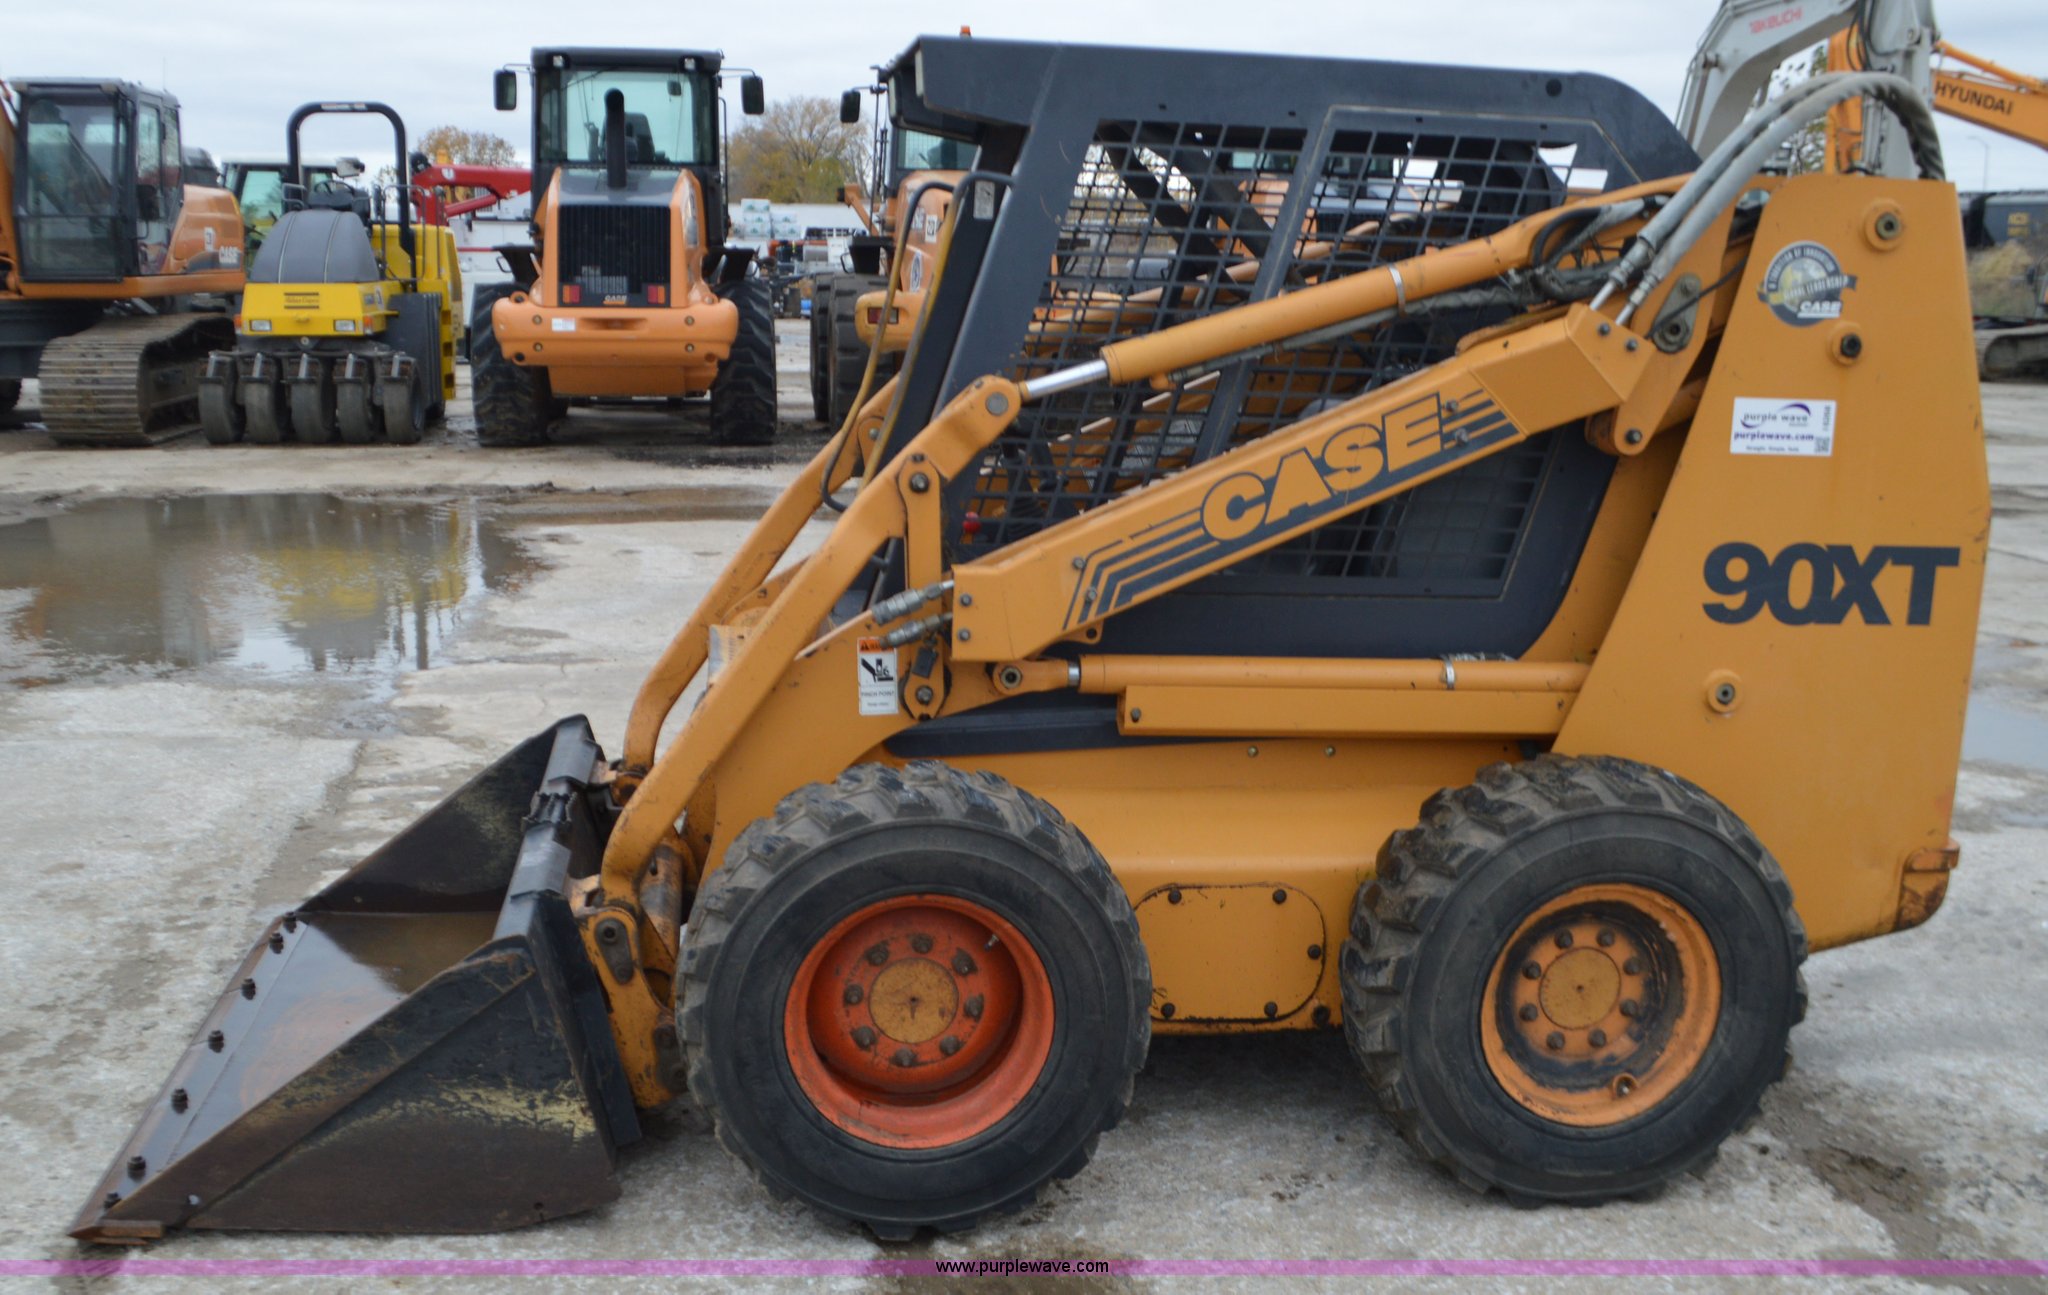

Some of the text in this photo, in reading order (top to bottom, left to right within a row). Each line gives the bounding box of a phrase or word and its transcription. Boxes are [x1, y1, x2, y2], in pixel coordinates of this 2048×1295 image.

[1935, 80, 2014, 115] HYUNDAI
[1800, 300, 1843, 313] CASE
[1743, 411, 1808, 422] purple wave
[1733, 430, 1815, 442] purplewave.com
[1202, 390, 1443, 541] CASE
[1702, 541, 1961, 627] 90XT
